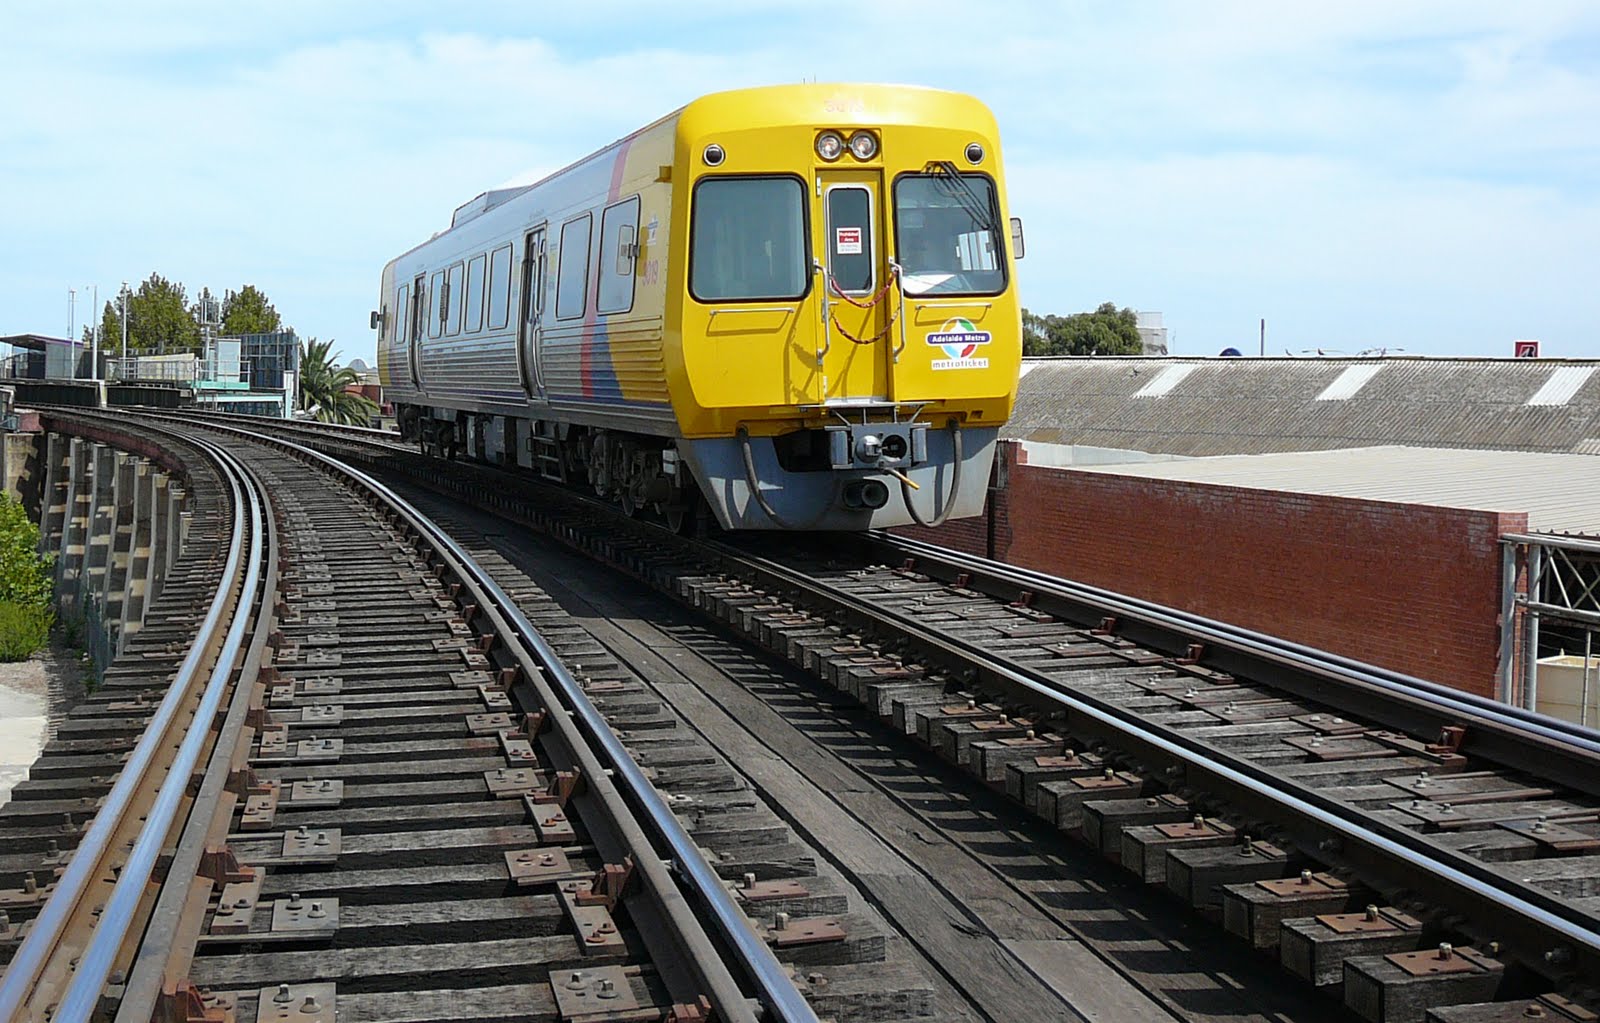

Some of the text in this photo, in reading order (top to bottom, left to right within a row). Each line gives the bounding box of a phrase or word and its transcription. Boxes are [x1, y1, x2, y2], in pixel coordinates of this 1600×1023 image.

[931, 334, 986, 343] Adelaide Metro
[932, 359, 987, 369] metroticket
